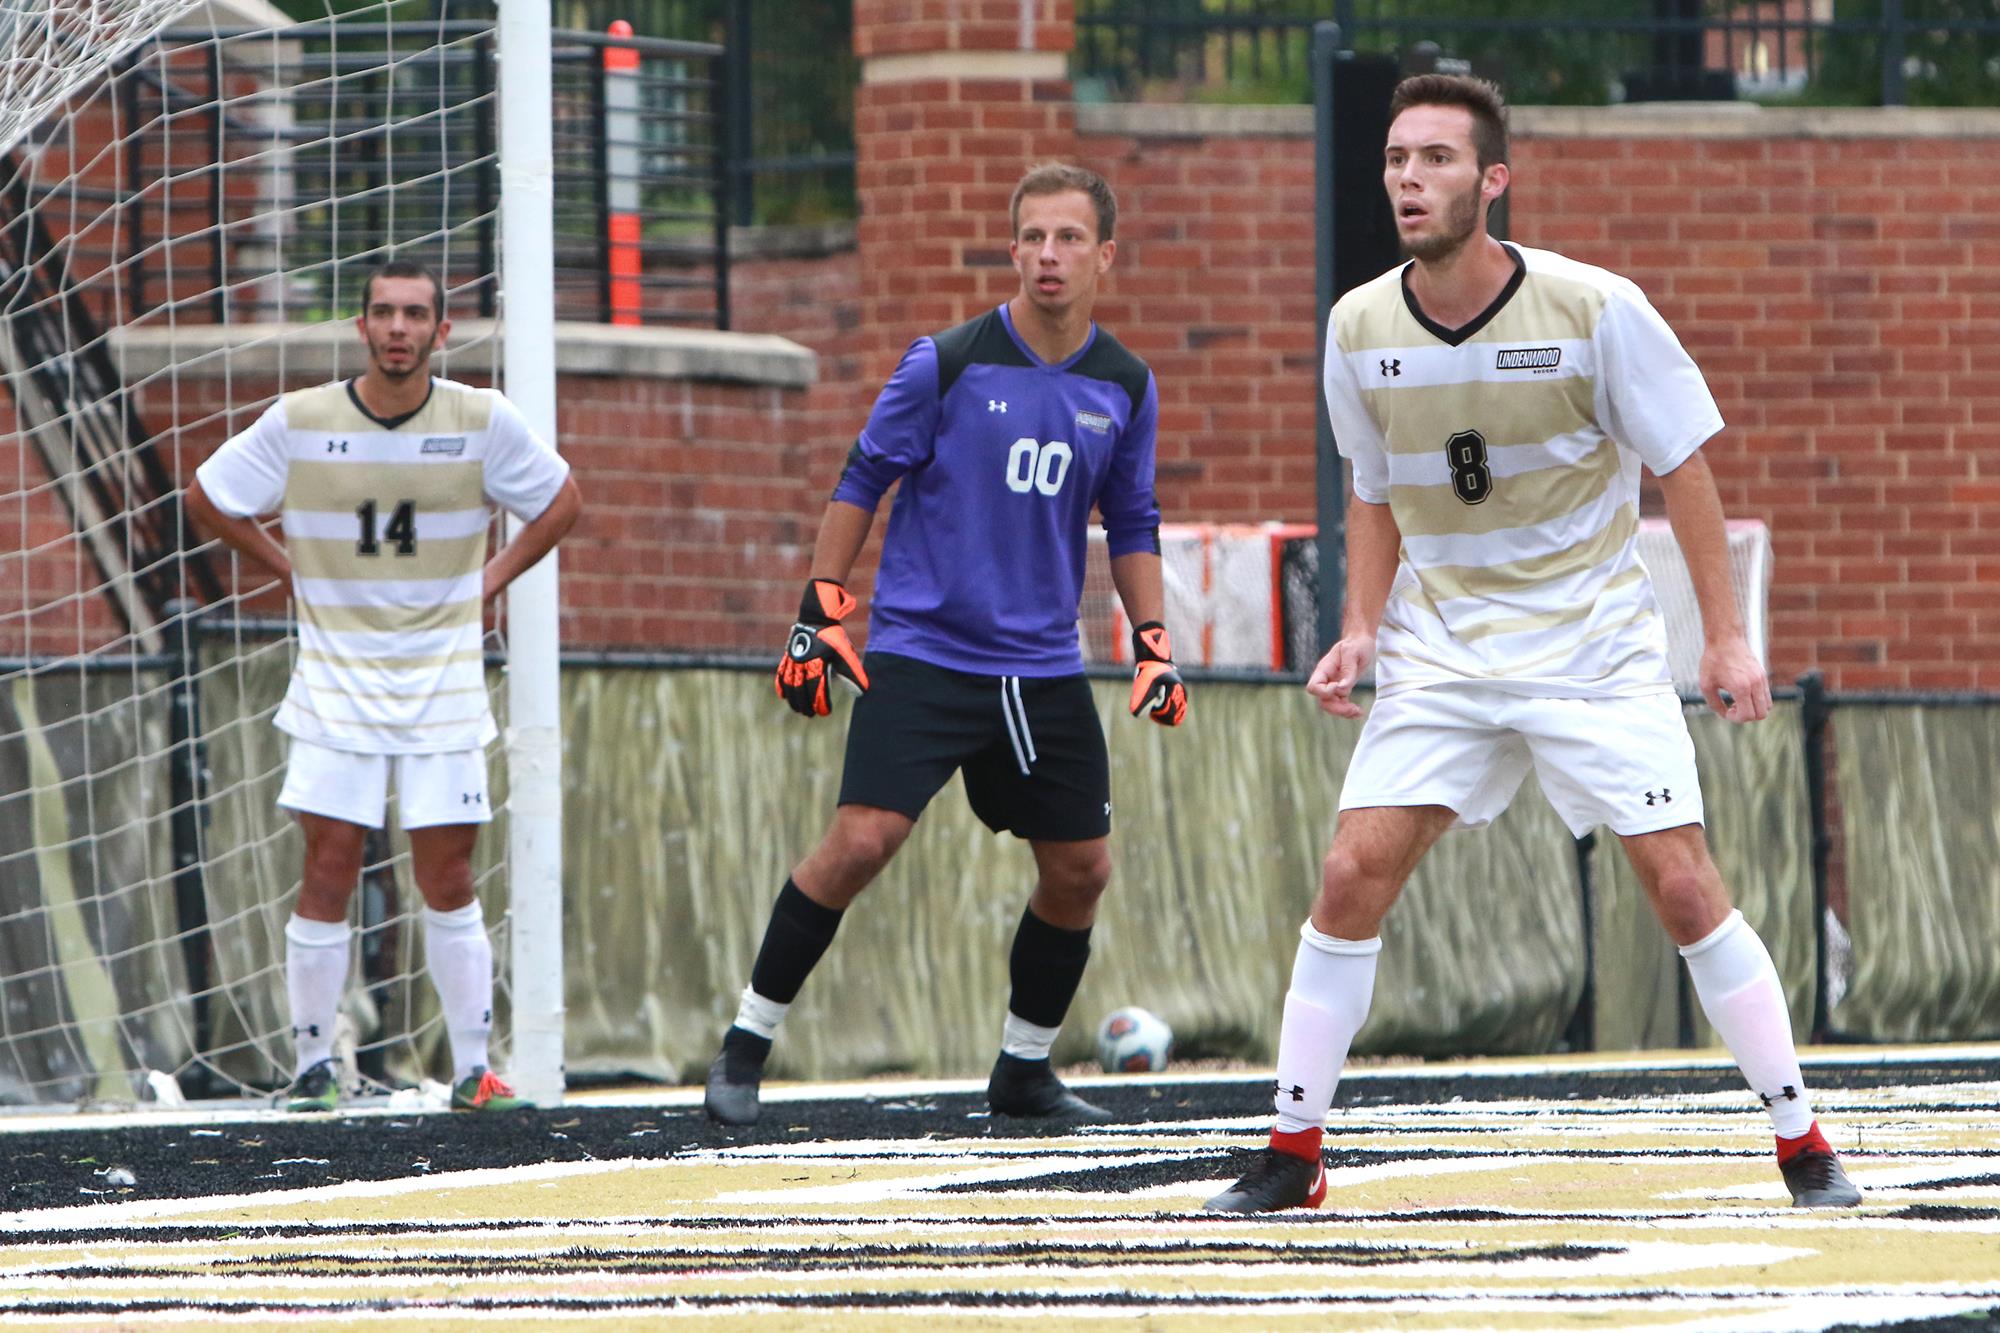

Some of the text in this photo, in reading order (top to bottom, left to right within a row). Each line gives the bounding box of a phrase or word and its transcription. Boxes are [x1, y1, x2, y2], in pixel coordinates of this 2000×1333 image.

[1498, 349, 1560, 367] LINDENWOOD
[1006, 437, 1073, 496] 00
[1446, 429, 1493, 505] 8
[356, 498, 417, 556] 14
